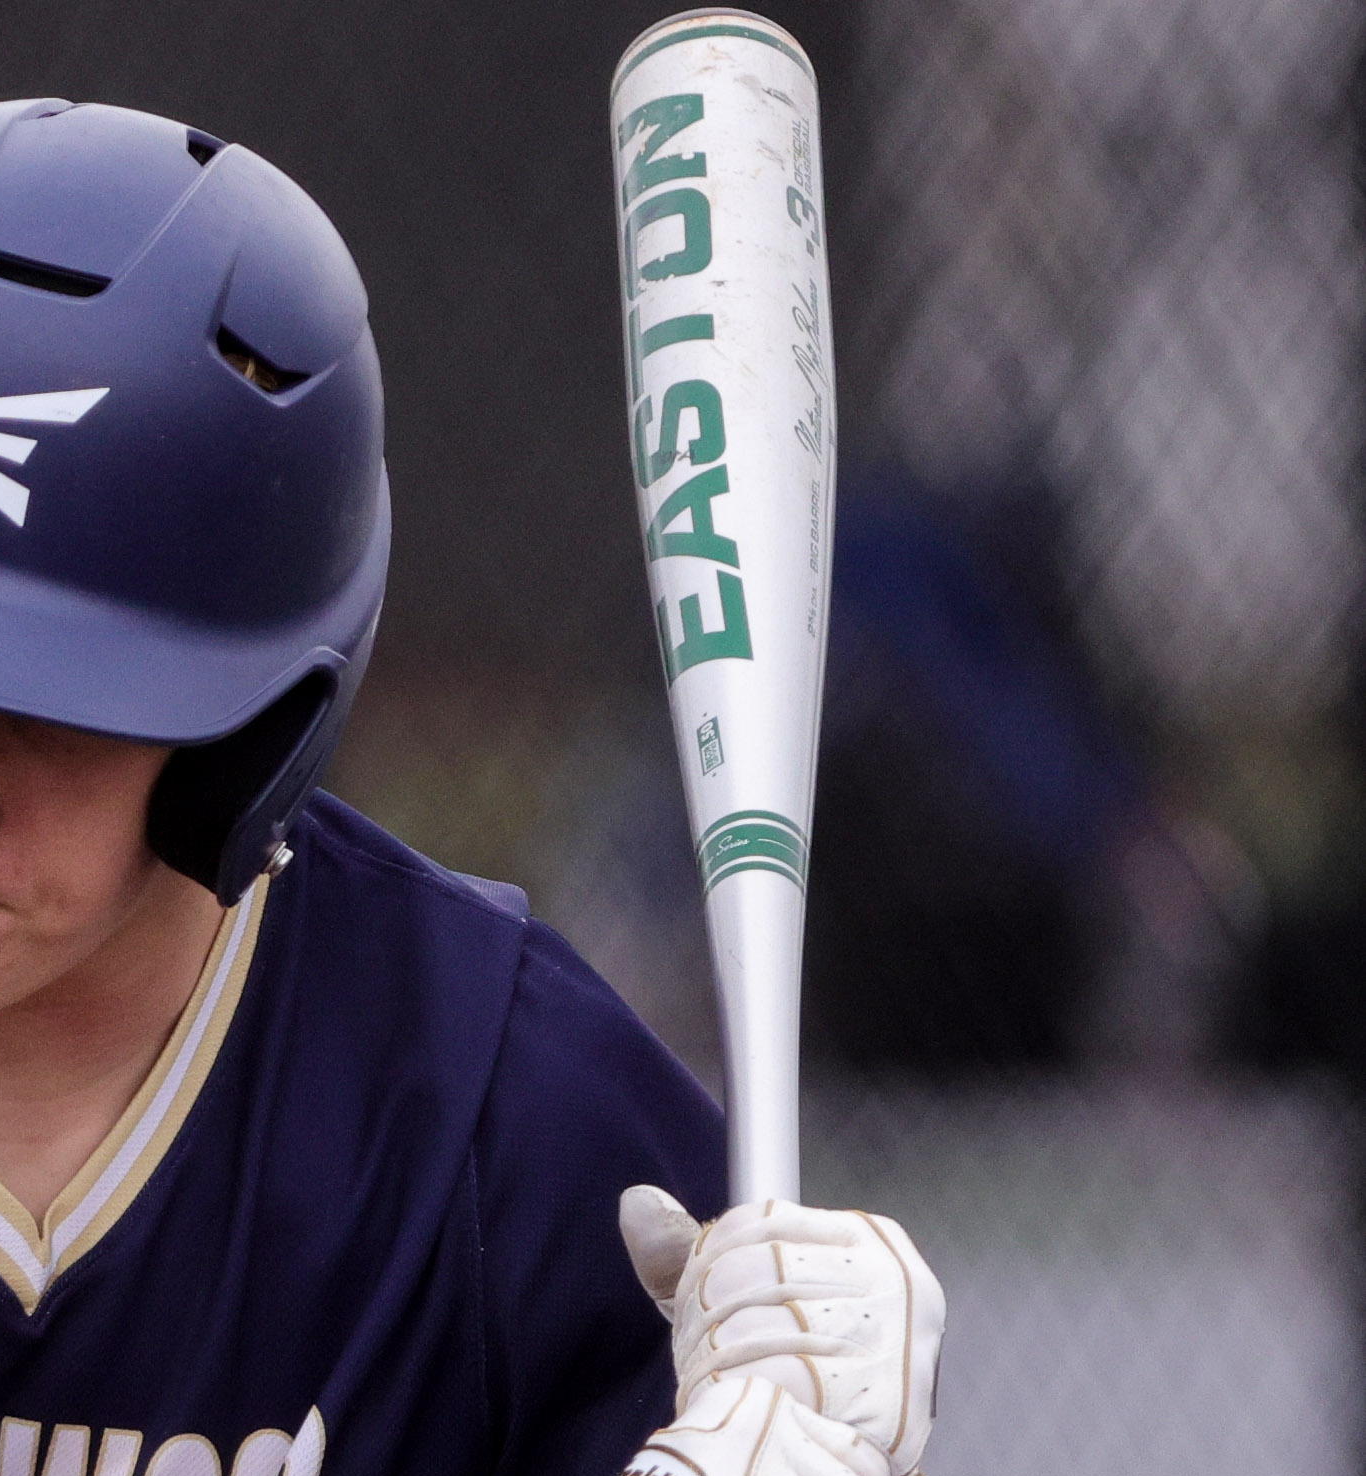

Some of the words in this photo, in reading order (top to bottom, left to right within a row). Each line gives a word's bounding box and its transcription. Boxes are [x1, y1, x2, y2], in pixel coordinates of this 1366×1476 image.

[786, 185, 823, 261] -3
[618, 92, 755, 690] EASTON
[810, 478, 821, 543] BARREL
[809, 542, 820, 574] BIG
[716, 835, 751, 856] Series
